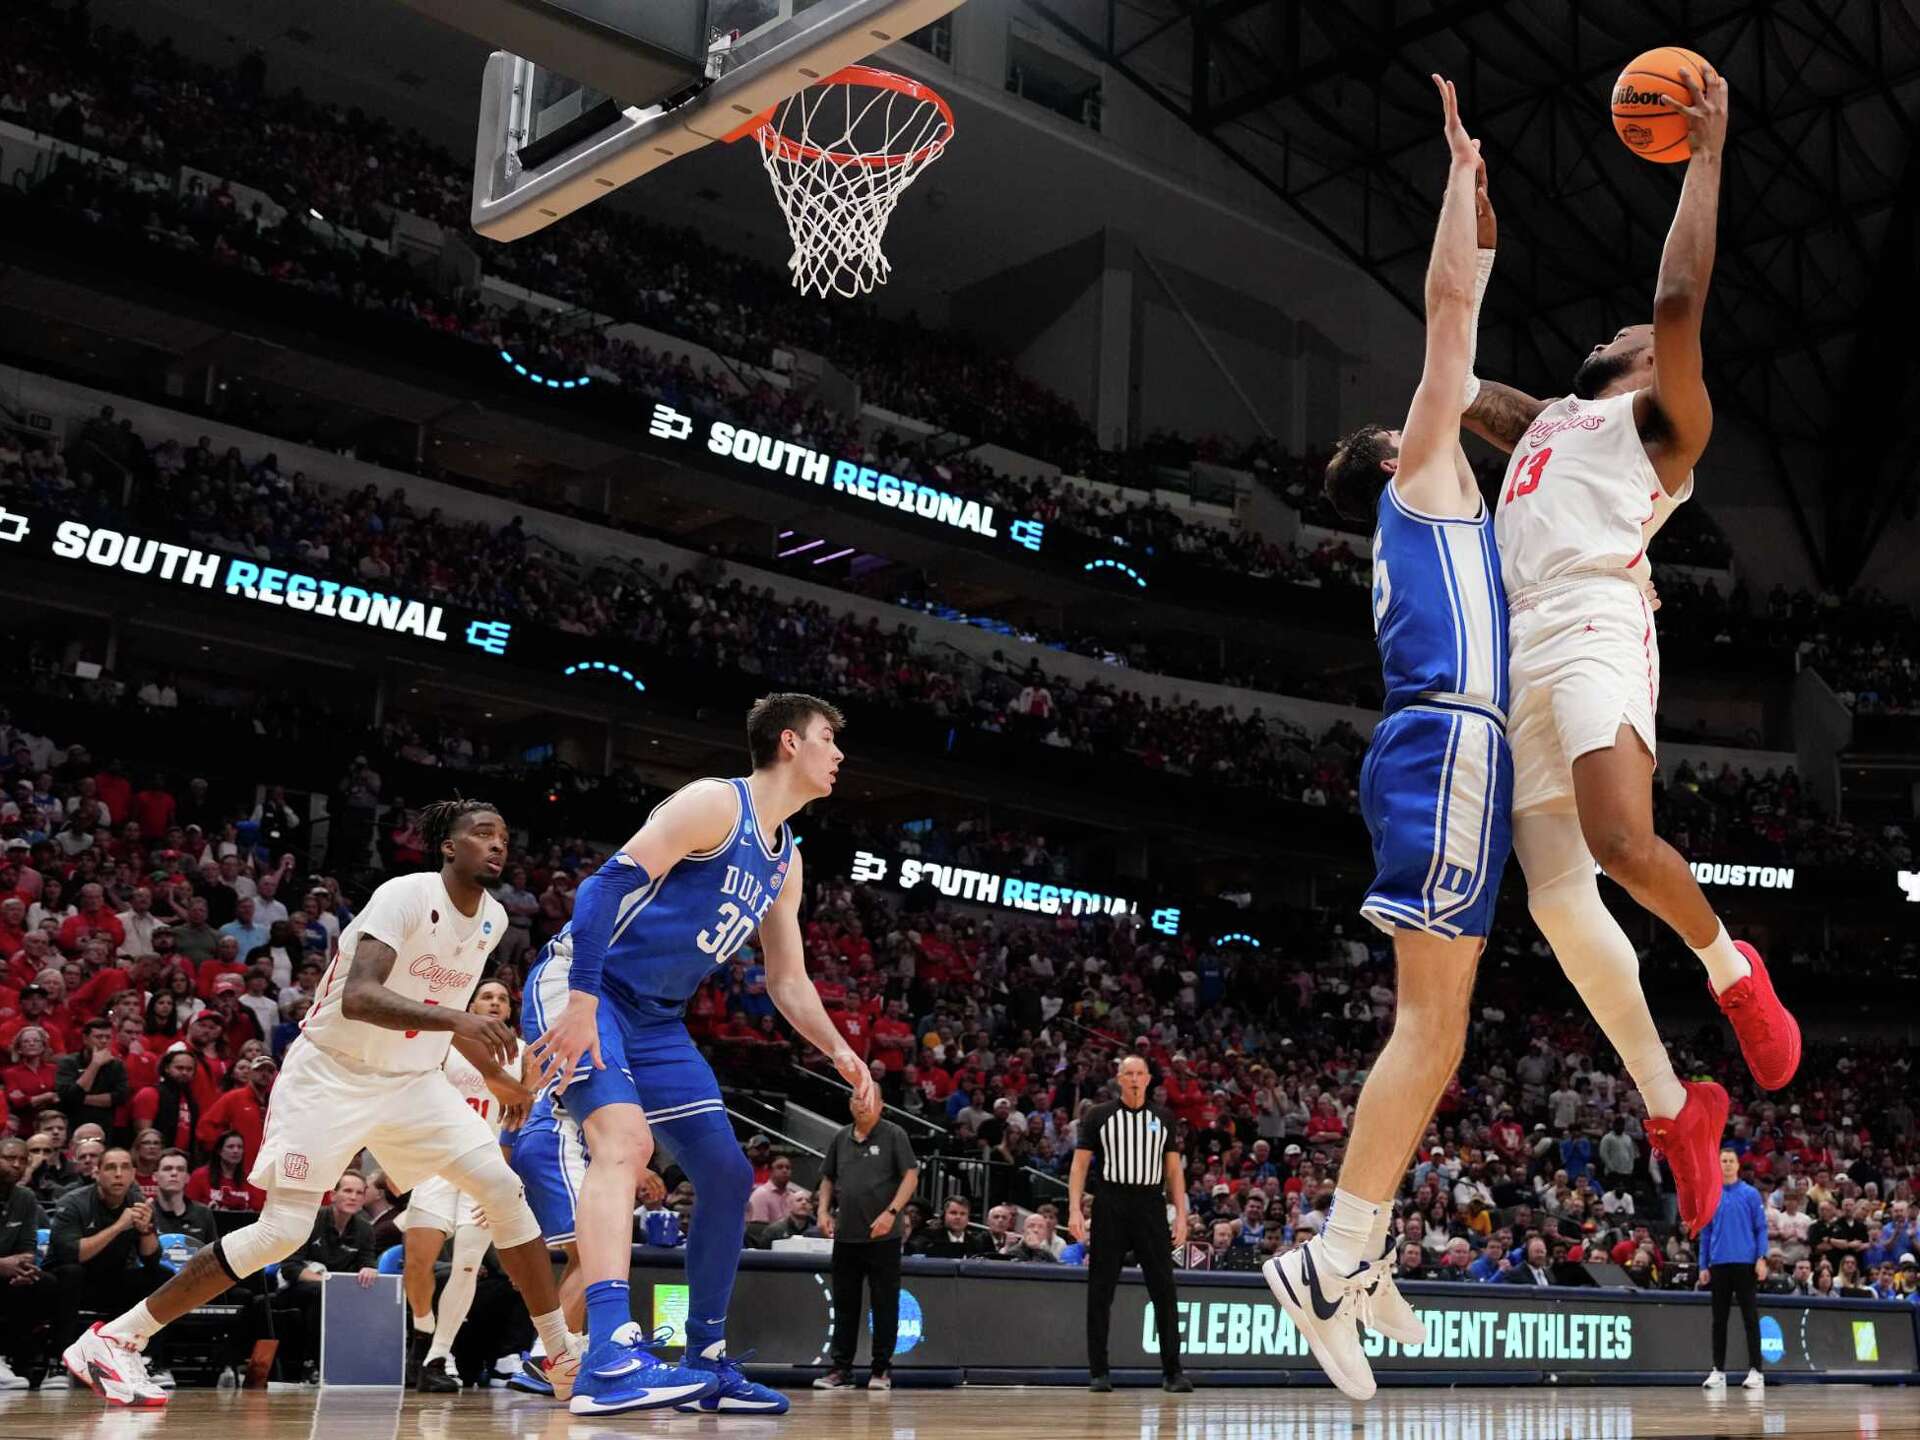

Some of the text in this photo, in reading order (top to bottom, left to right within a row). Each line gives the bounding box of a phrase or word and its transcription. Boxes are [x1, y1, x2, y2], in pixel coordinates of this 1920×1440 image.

[707, 421, 997, 538] SOUTH REGIONAL
[1505, 447, 1553, 505] 13
[52, 520, 447, 641] SOUTH REGIONAL
[720, 864, 774, 923] DUKE
[696, 902, 755, 964] 30
